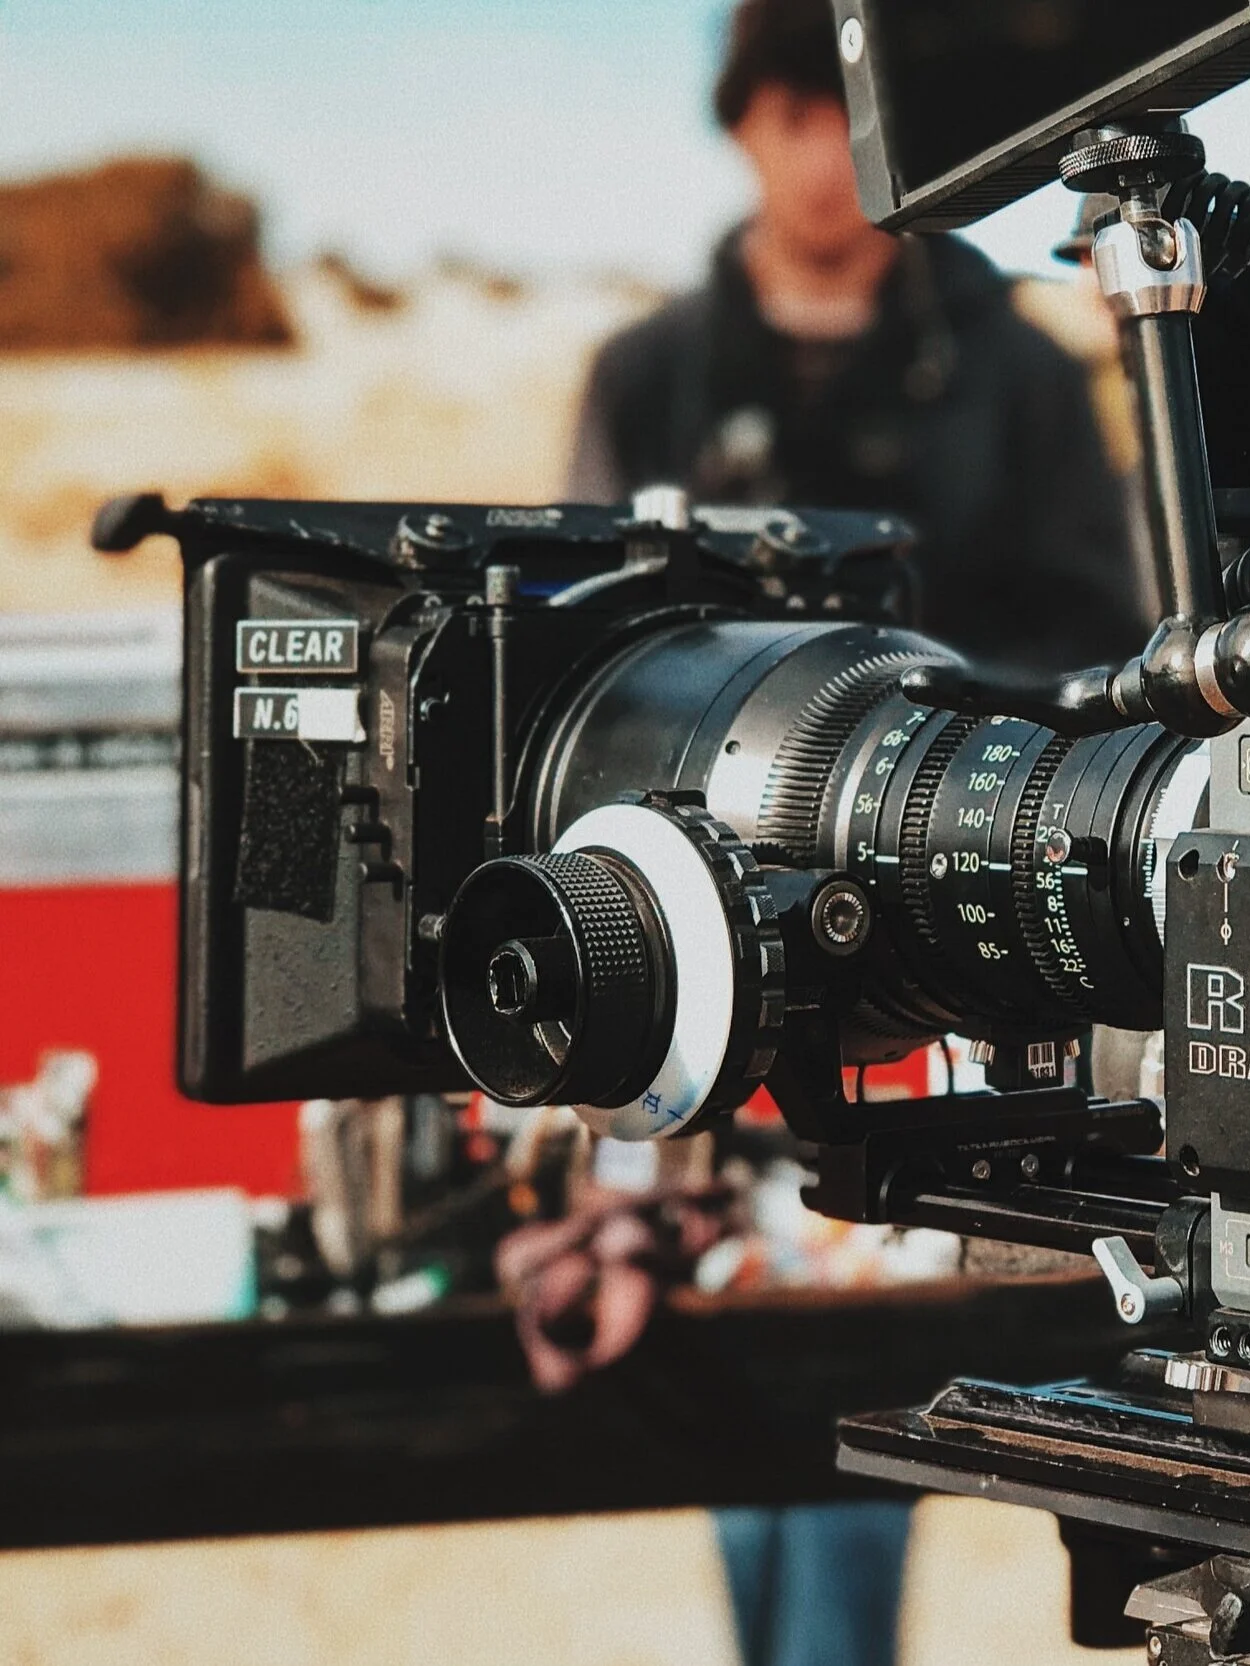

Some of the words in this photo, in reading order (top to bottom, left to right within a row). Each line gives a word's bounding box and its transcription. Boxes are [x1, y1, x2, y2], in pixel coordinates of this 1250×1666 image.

[249, 630, 344, 663] CLEAR
[906, 711, 924, 726] 7
[981, 744, 1013, 762] 180
[875, 757, 890, 775] 6
[967, 772, 996, 791] 160
[957, 807, 985, 829] 140
[1052, 803, 1065, 820] T
[857, 841, 868, 861] 5
[952, 851, 980, 873] 120
[1047, 895, 1059, 912] 8
[957, 903, 987, 924] 100
[1044, 917, 1062, 934] 11
[978, 941, 1001, 959] 85
[1051, 938, 1071, 955] 16
[1059, 958, 1082, 973] 22
[1219, 1239, 1234, 1256] M3
